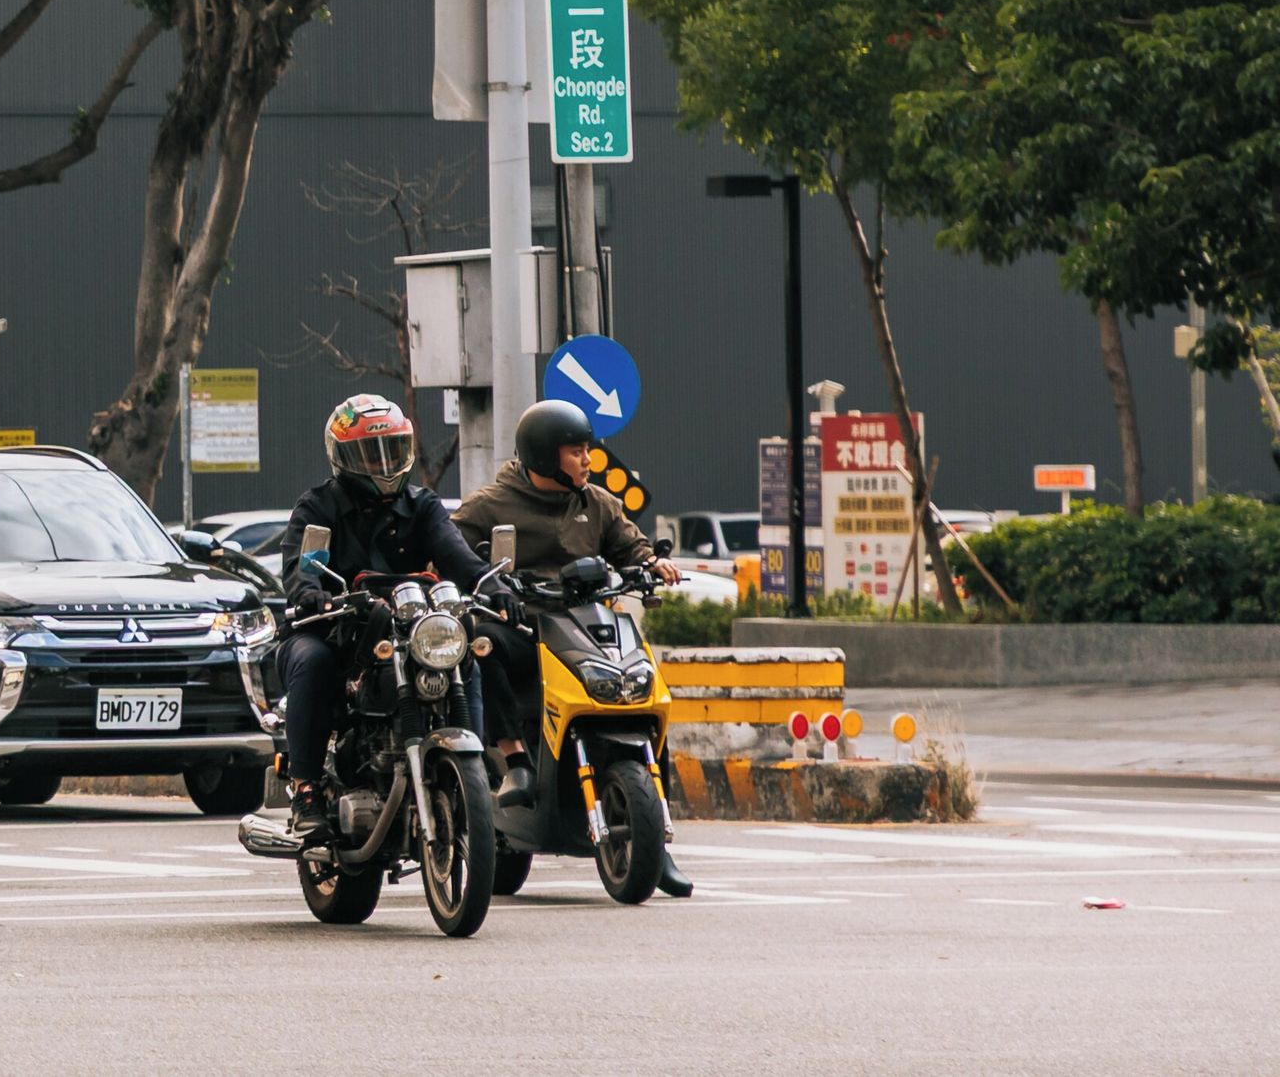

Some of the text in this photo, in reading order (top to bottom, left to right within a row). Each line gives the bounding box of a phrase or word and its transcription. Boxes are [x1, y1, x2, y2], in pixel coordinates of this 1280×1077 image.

[554, 76, 625, 102] Chongde
[578, 104, 605, 126] Rd.
[571, 131, 614, 153] Sec.2
[768, 549, 782, 572] 80
[58, 603, 191, 611] OUTLANDER
[99, 701, 179, 723] BMD-7129
